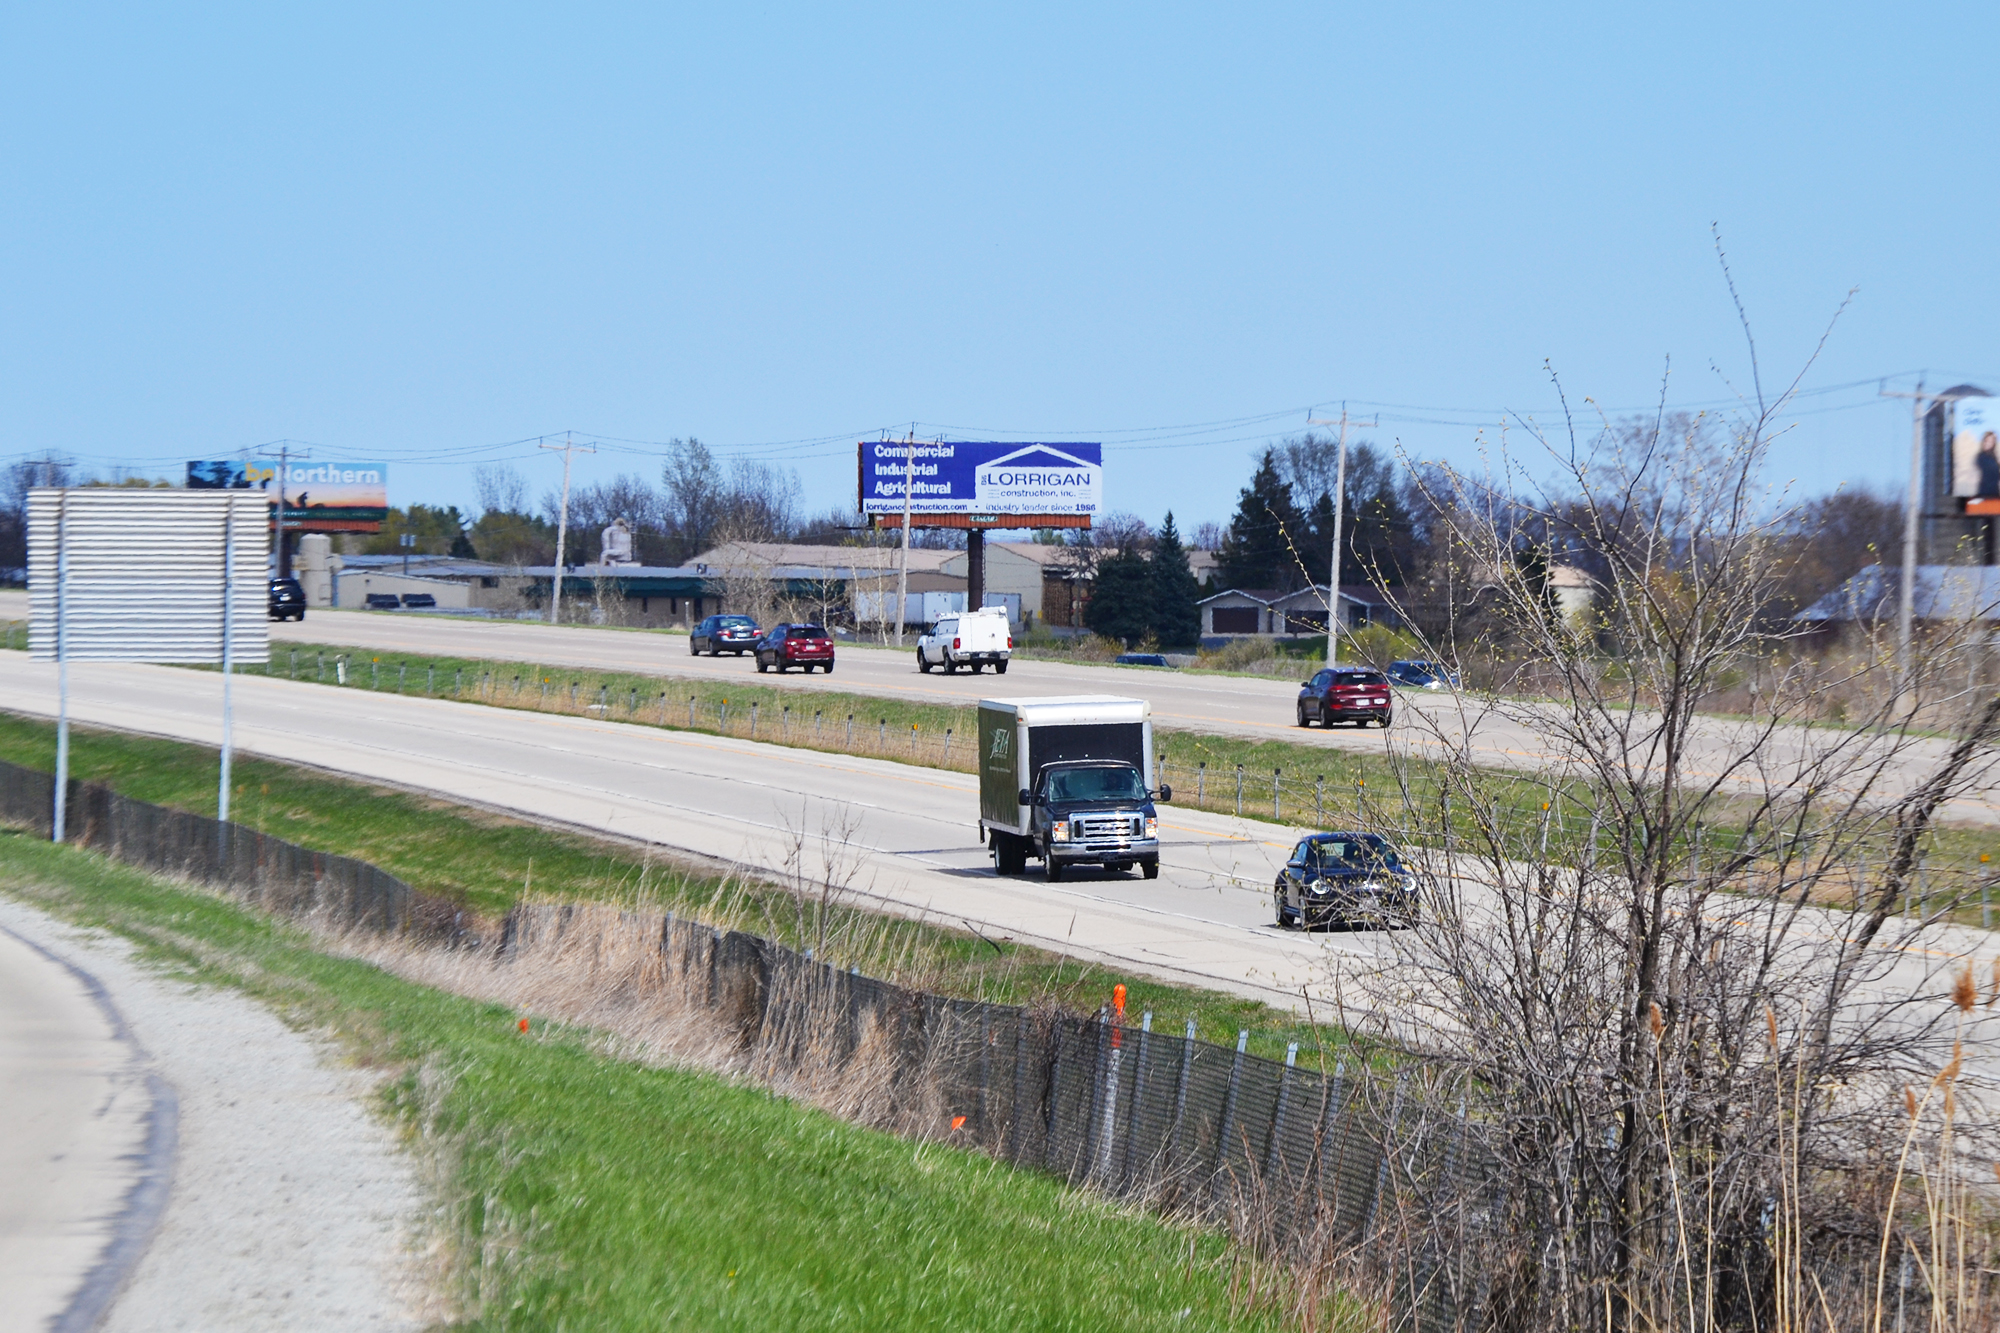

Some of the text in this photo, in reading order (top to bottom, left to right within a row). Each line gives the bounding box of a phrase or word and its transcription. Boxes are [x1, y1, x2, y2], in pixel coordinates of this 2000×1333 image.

[874, 444, 955, 458] Commercial
[875, 462, 938, 476] Industrial
[988, 473, 1091, 486] LORRIGAN
[874, 481, 951, 496] Agricultural
